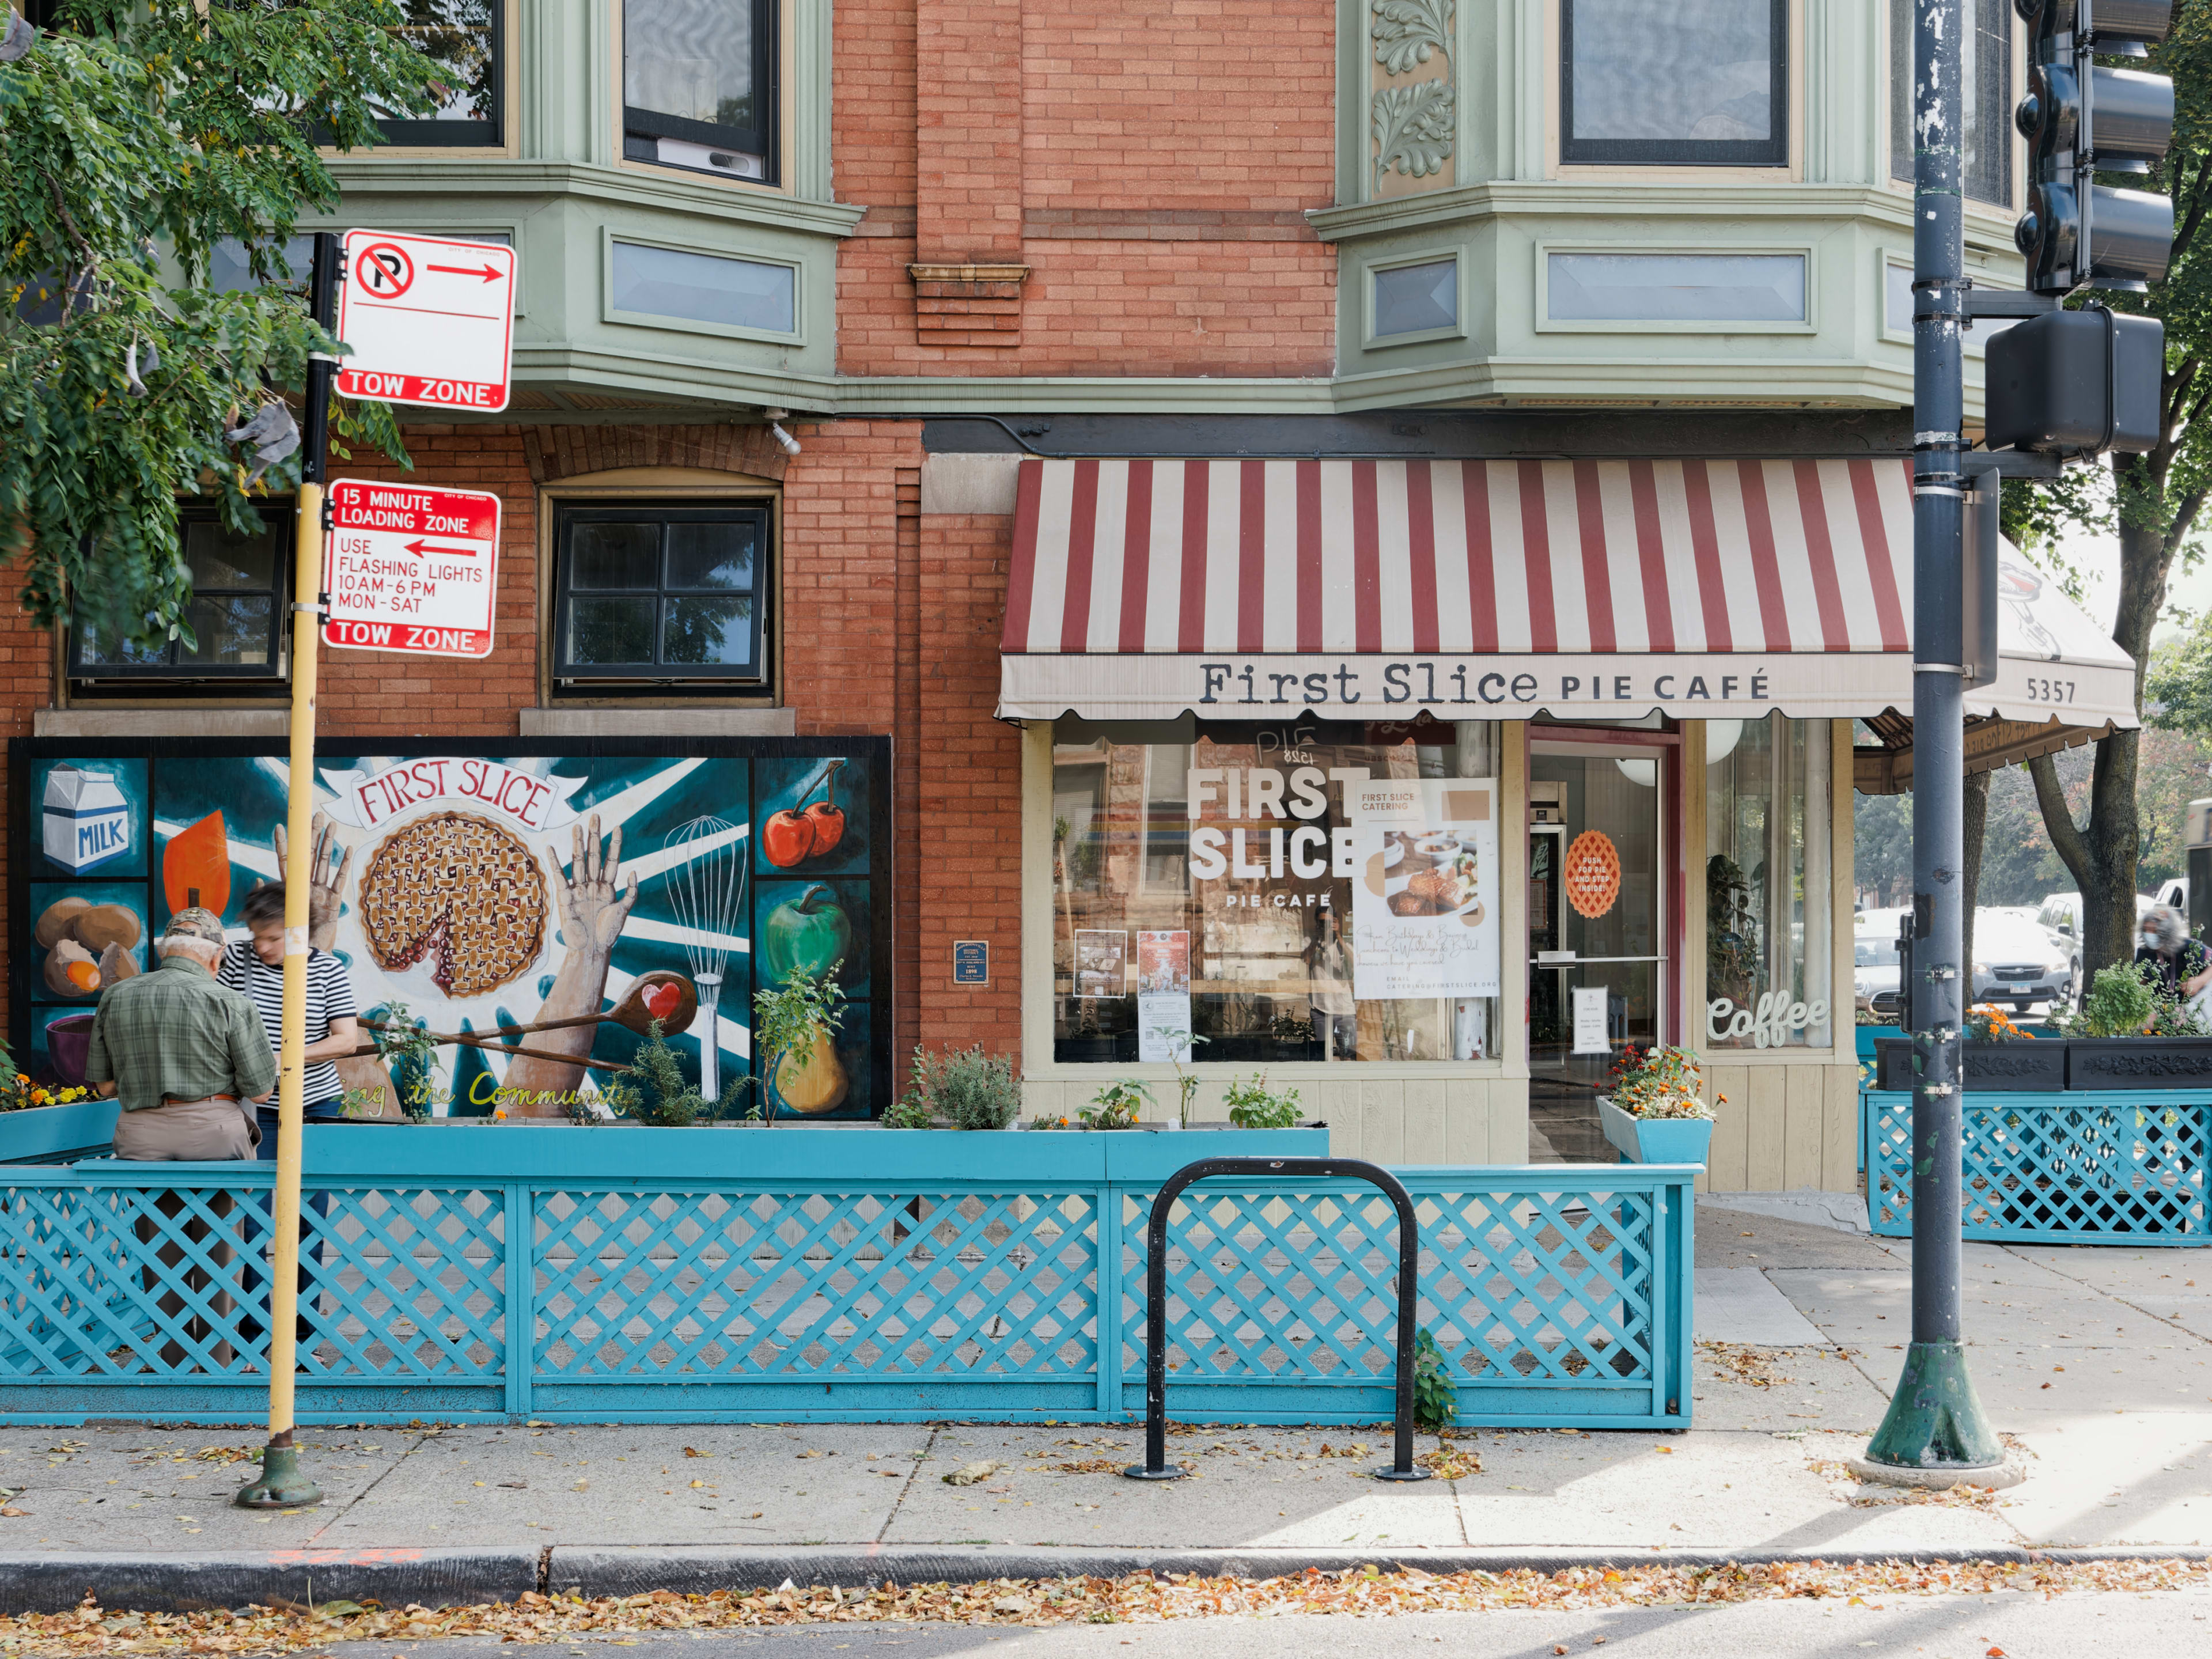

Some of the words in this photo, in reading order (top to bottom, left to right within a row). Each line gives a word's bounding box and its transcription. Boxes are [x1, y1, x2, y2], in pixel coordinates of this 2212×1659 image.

[348, 372, 404, 396] TOW
[419, 379, 491, 405] ZONE
[342, 488, 360, 505] 15
[369, 491, 433, 512] MINUTE
[341, 508, 415, 529] LOADING
[425, 515, 469, 534] ZONE
[340, 538, 372, 555] USE
[339, 556, 418, 578] FLASHING
[429, 564, 483, 583] LIGHTS
[336, 622, 392, 645] TOW
[406, 628, 476, 652] ZONE
[1198, 662, 1361, 704] First
[1383, 662, 1538, 704] Slice
[1561, 676, 1633, 700] PIE
[1653, 668, 1770, 700] CAFÉ
[2027, 678, 2075, 704] 5357
[357, 760, 451, 825] FIRST
[457, 760, 551, 827] SLICE
[1187, 767, 1370, 819] FIRST
[1362, 802, 1408, 810] CATERING
[78, 818, 126, 859] MILK
[1188, 826, 1368, 880] SLICE
[1226, 895, 1261, 908] PIE
[1706, 990, 1831, 1048] Coffee
